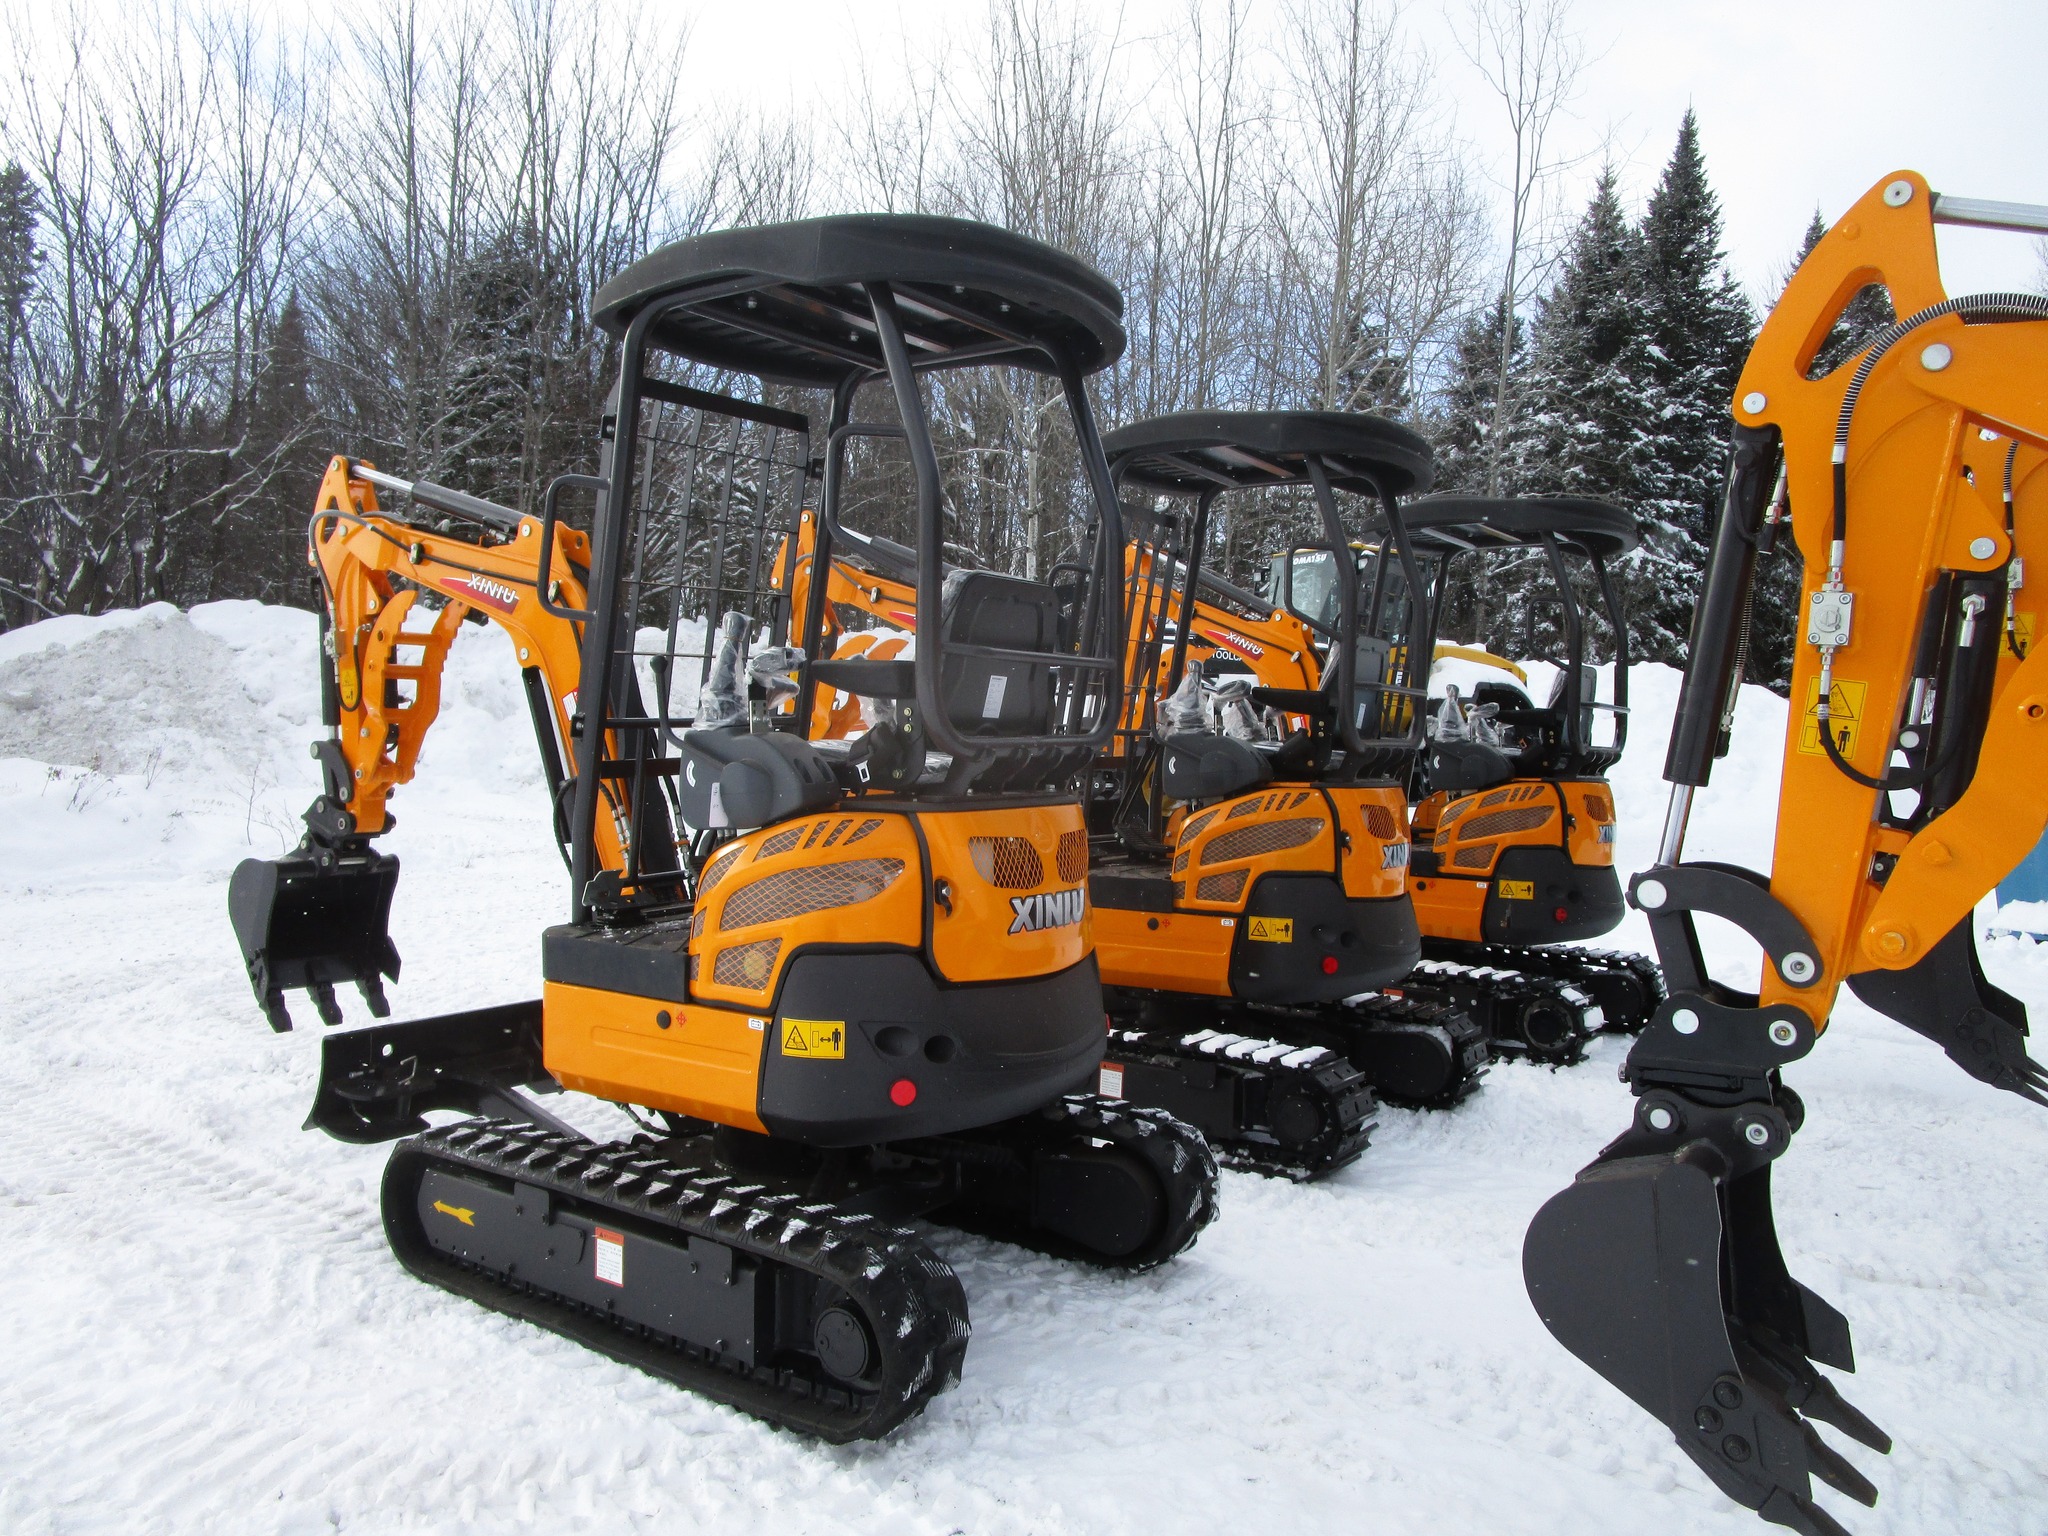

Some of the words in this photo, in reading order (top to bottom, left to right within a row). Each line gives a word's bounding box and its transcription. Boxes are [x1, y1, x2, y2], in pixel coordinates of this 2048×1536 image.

[1293, 553, 1327, 565] OMATSU
[467, 573, 516, 604] XINIU
[1226, 631, 1263, 655] XINIU
[1212, 650, 1243, 662] OOLC
[1008, 887, 1085, 935] XINIU
